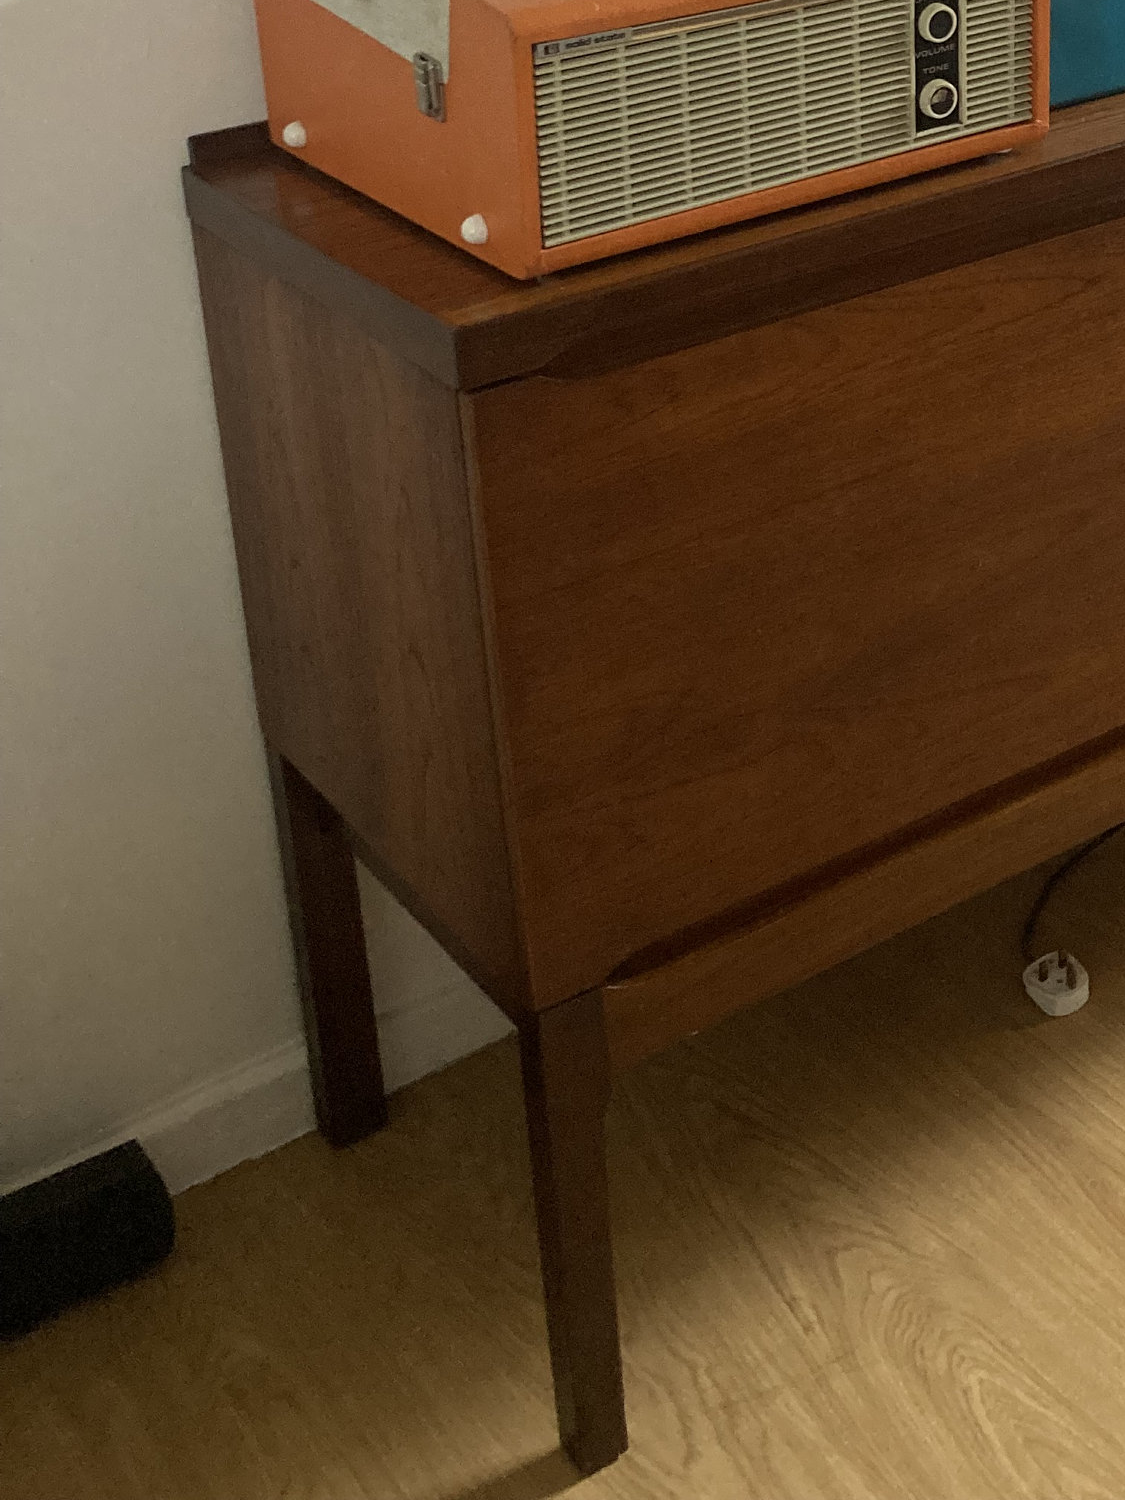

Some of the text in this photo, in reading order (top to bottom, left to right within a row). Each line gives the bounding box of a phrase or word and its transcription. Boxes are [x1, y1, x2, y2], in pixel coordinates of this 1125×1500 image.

[564, 32, 626, 49] solid state
[915, 43, 955, 59] VOLUME
[922, 62, 950, 75] TONE
